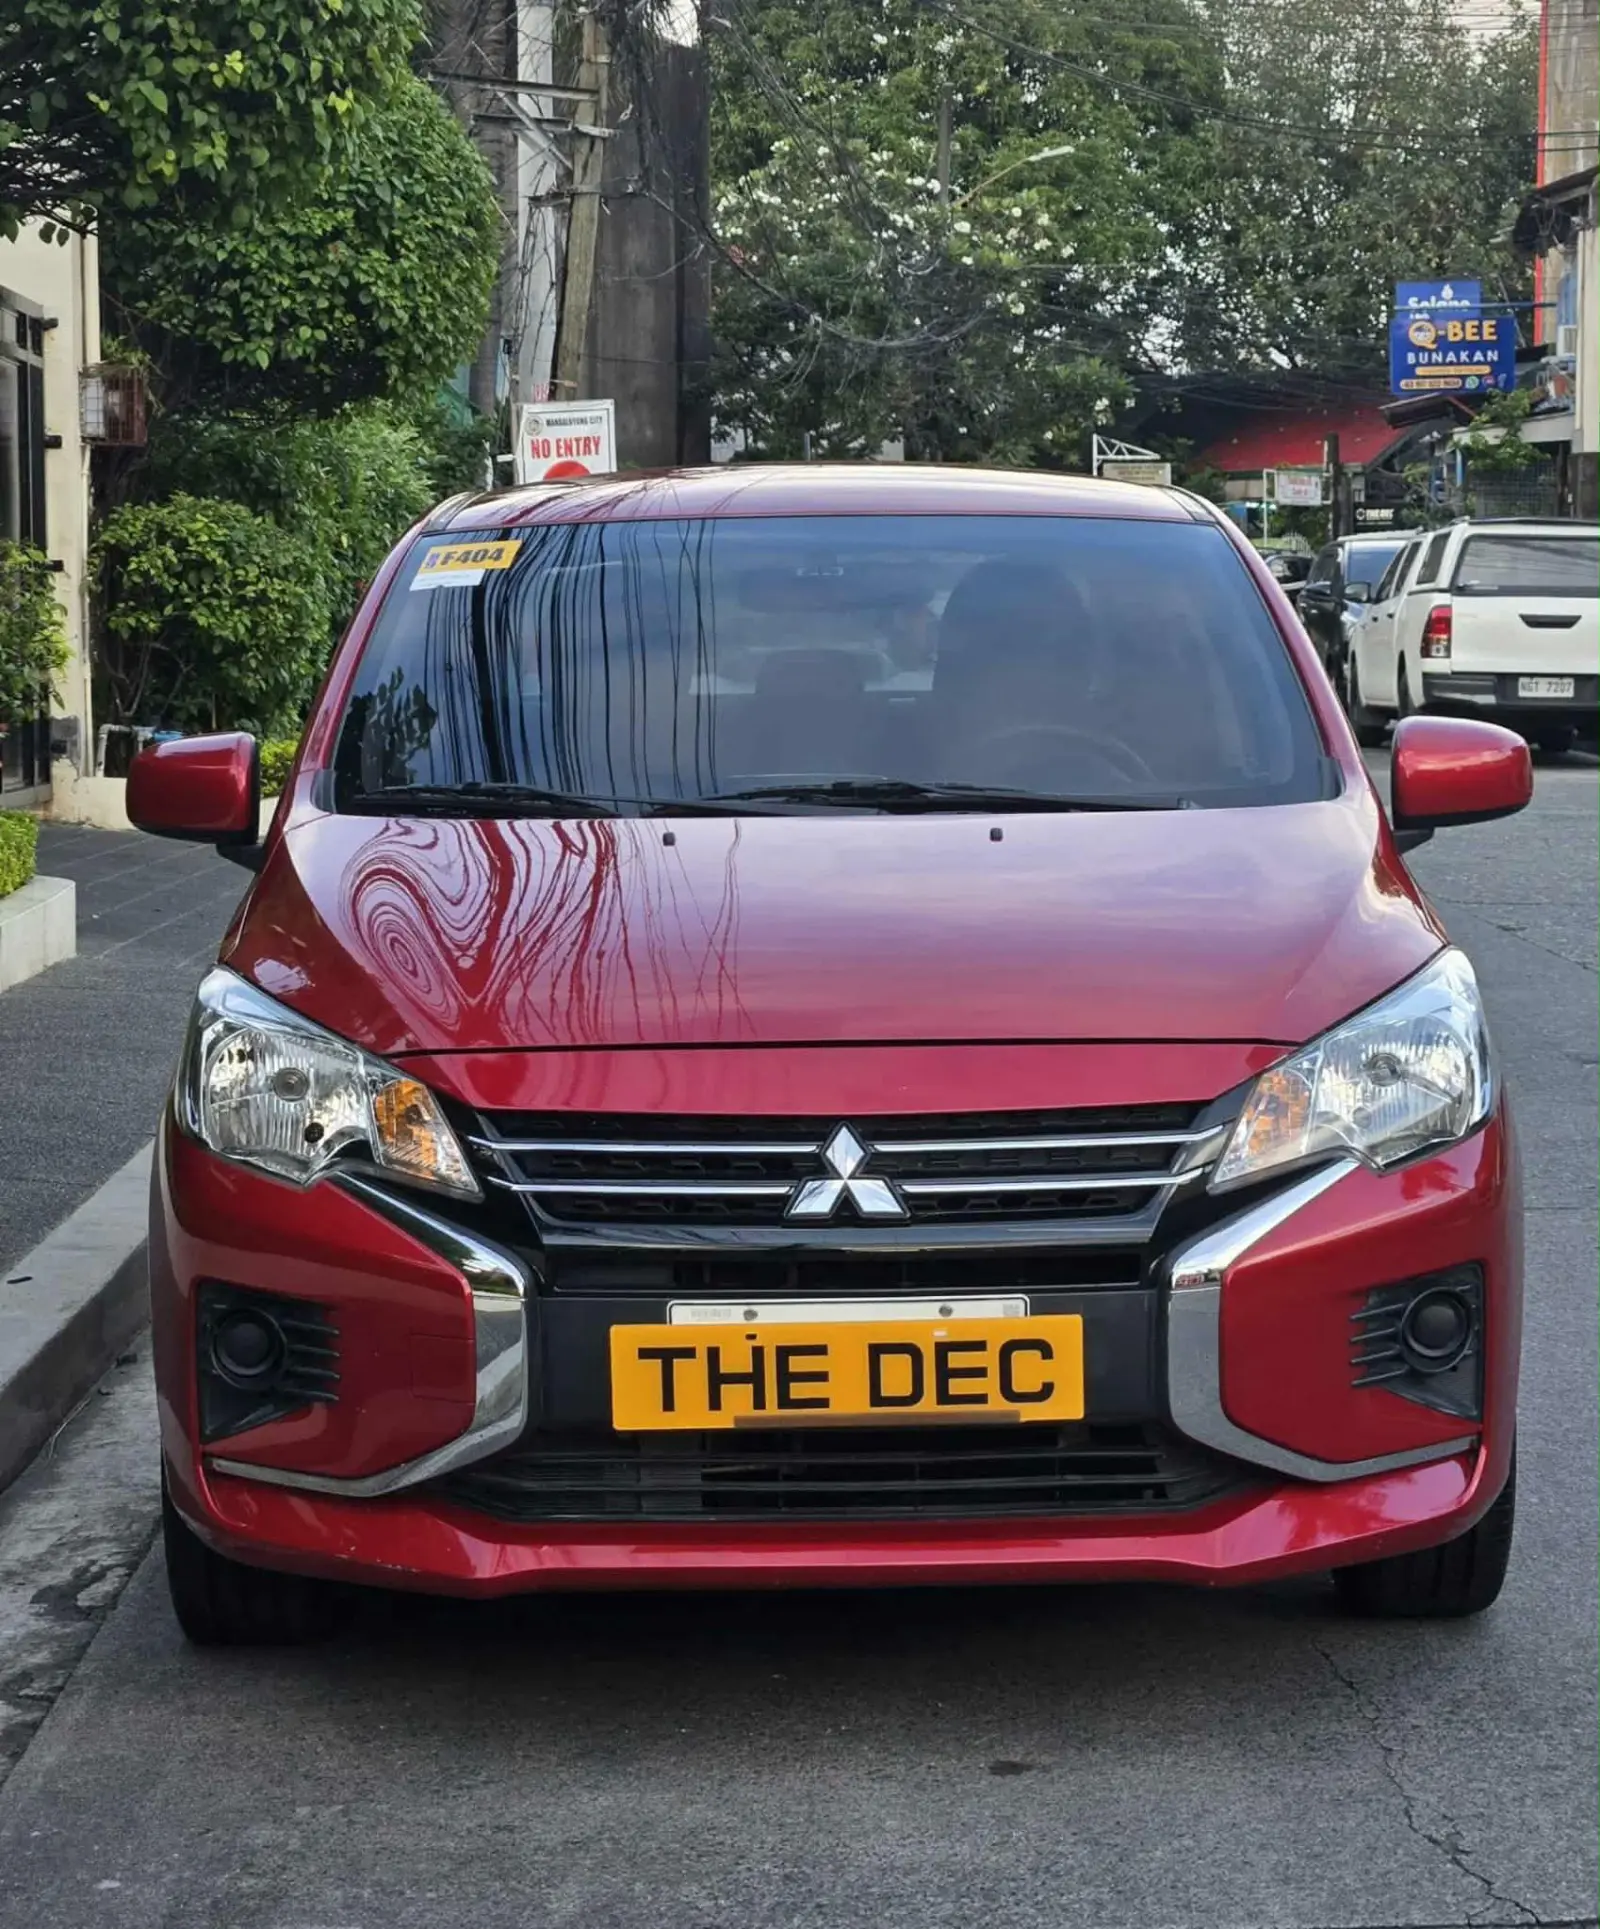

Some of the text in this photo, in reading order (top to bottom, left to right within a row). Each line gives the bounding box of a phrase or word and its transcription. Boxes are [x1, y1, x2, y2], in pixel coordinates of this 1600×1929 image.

[1408, 320, 1498, 349] Q-BEE
[1407, 350, 1499, 364] BUNAKAN
[530, 436, 601, 459] NO ENTRY
[638, 1338, 1056, 1413] THE DEC
